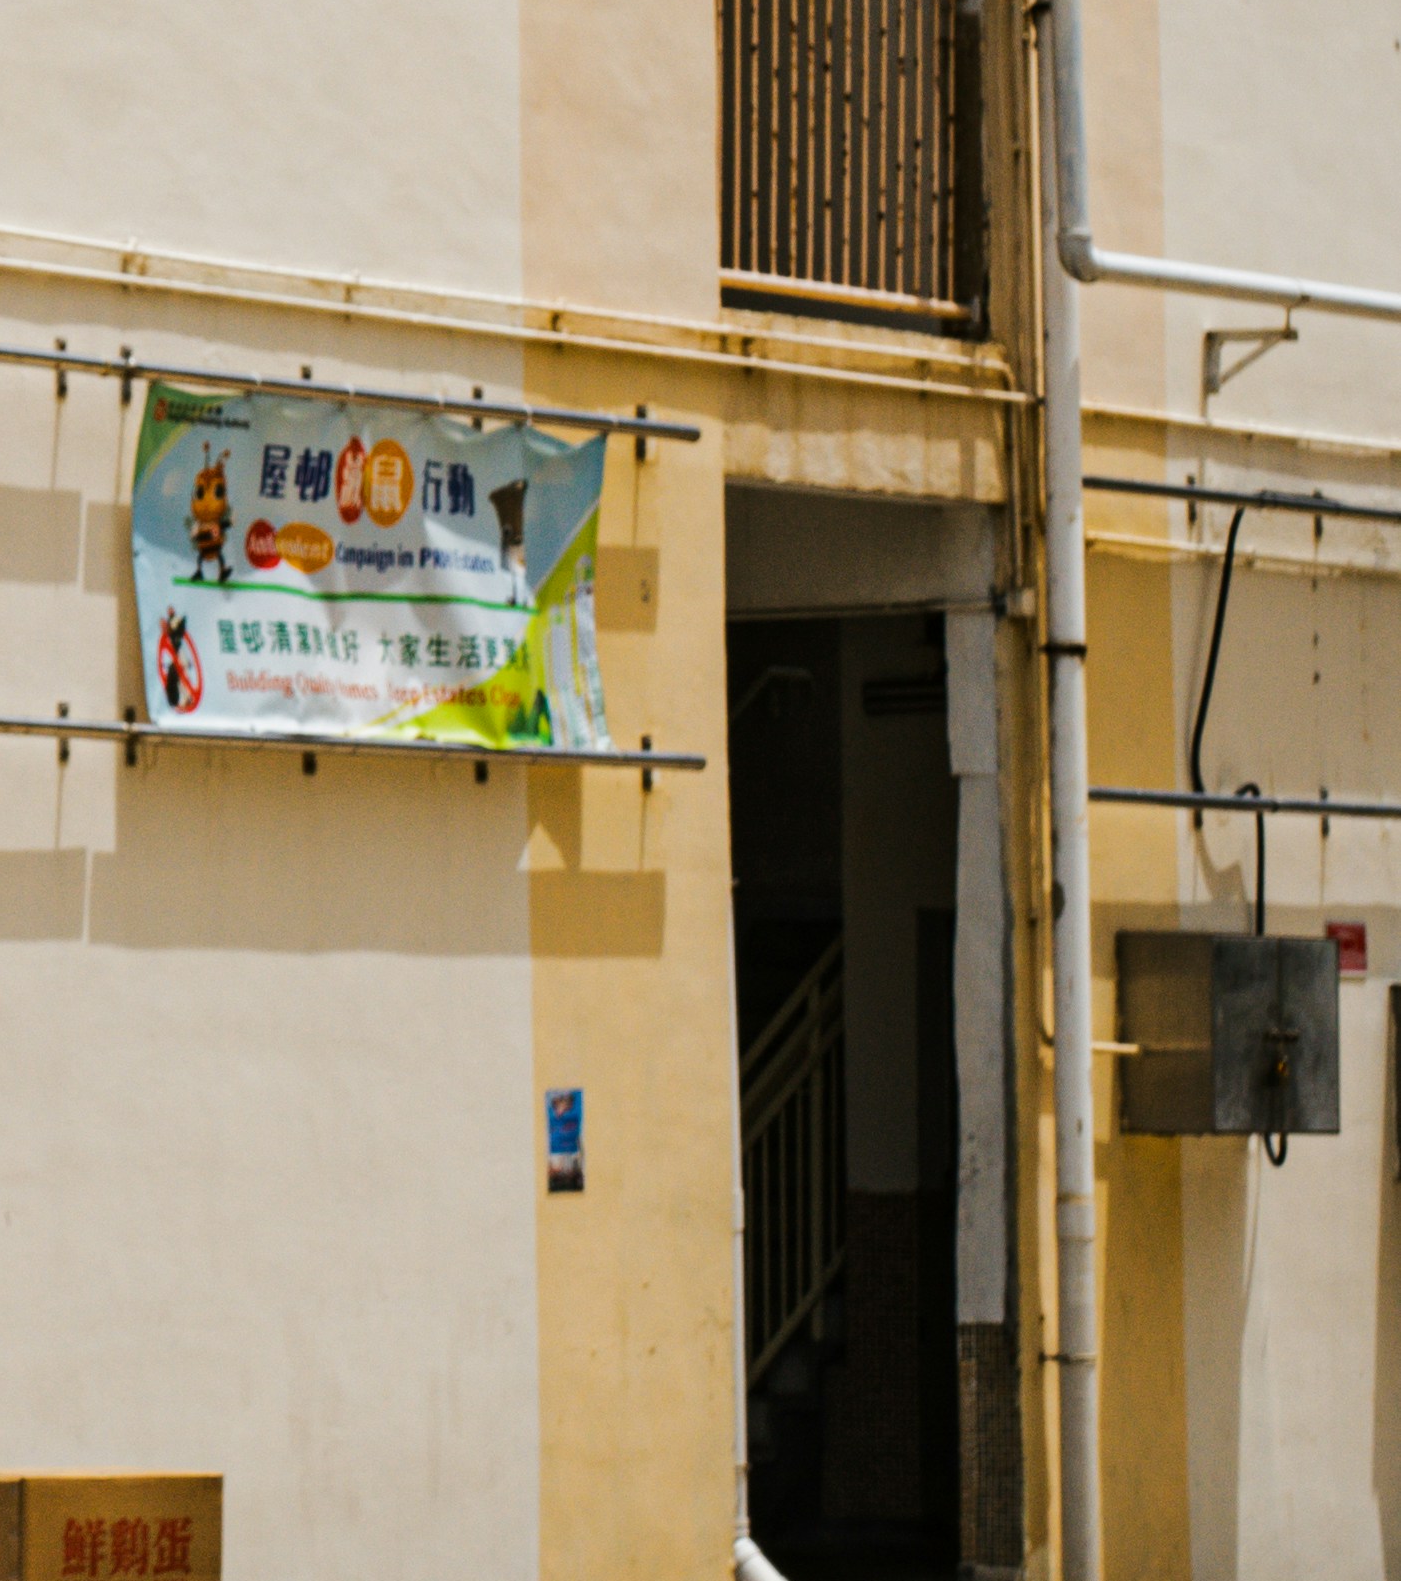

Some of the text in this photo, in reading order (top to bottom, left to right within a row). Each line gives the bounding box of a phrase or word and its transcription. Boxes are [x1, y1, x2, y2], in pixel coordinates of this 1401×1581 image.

[335, 542, 396, 572] Campaign
[398, 543, 414, 568] in
[226, 669, 294, 698] Building
